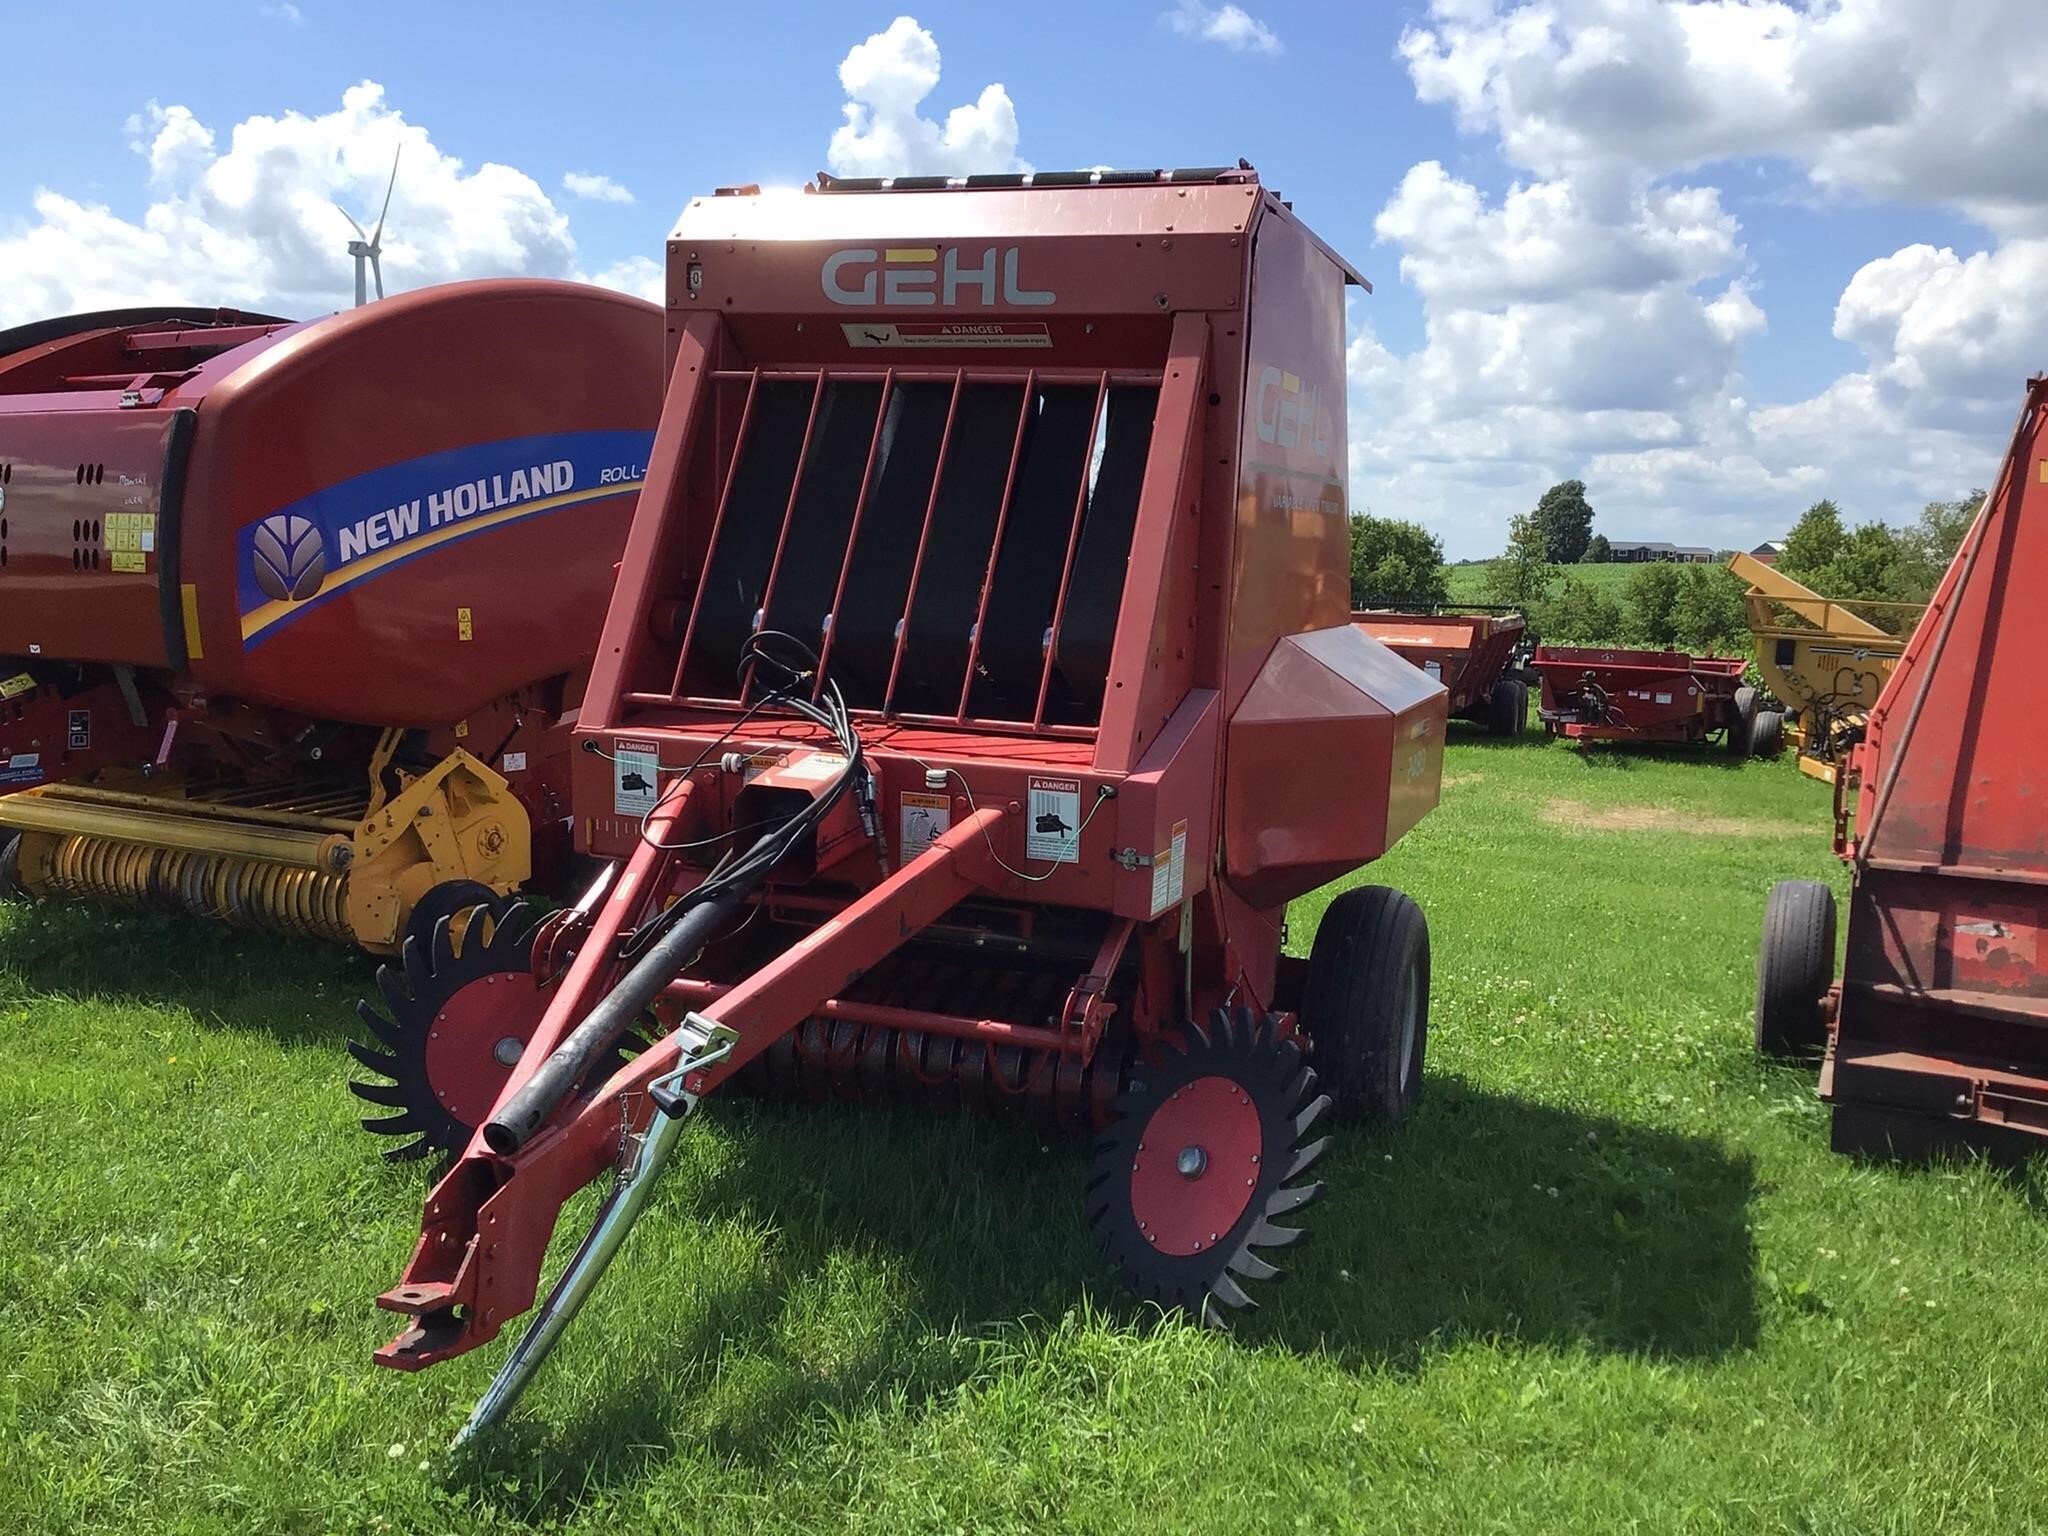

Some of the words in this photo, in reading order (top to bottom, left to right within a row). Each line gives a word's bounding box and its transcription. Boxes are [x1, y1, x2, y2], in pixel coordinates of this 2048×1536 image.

[821, 247, 1056, 305] GEHL
[952, 325, 1003, 334] DANGER
[339, 500, 420, 562] NEW
[428, 460, 574, 527] HOLLAND
[626, 742, 655, 752] DANGER
[1042, 781, 1076, 791] DANGER
